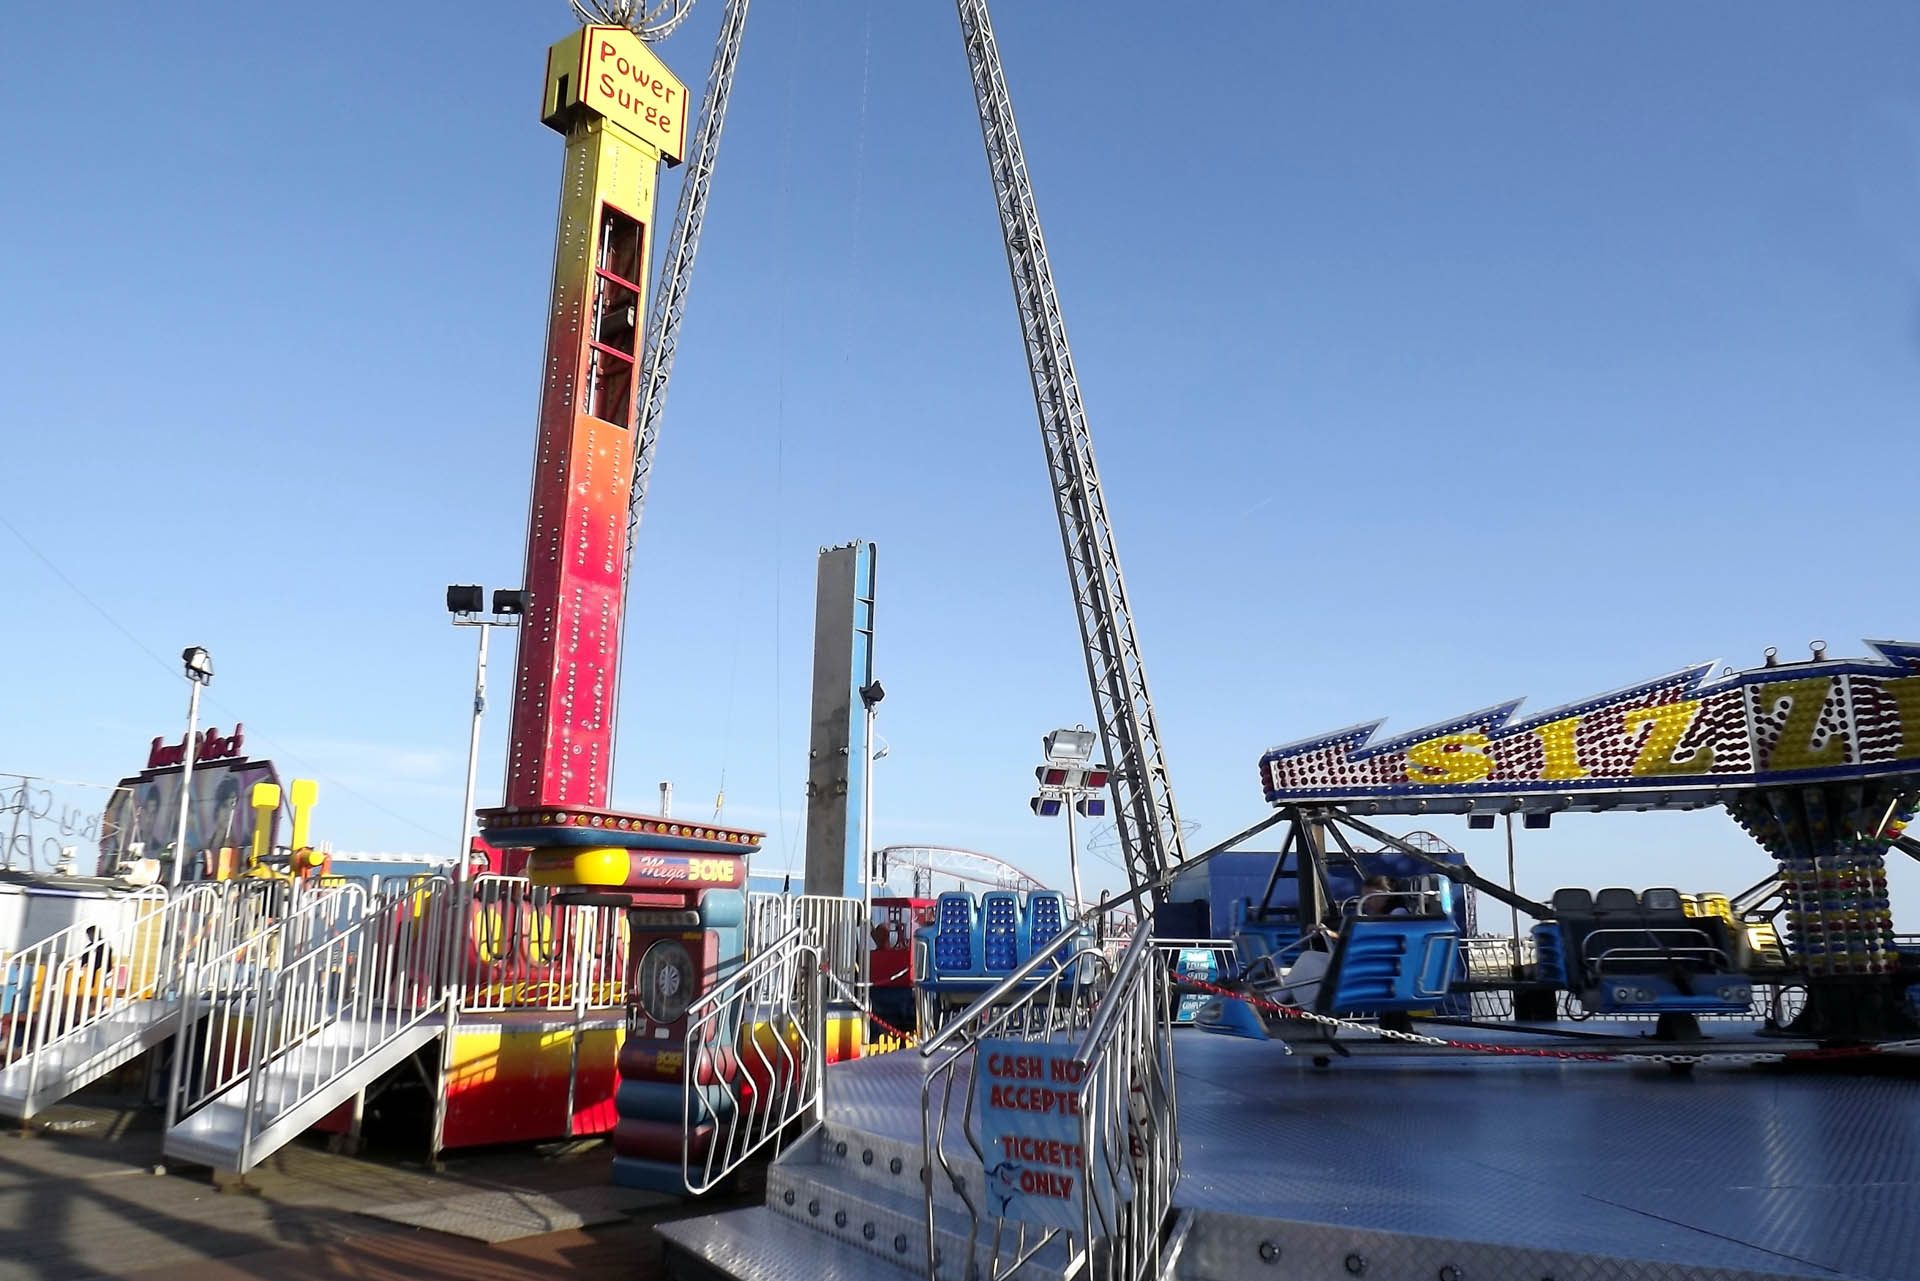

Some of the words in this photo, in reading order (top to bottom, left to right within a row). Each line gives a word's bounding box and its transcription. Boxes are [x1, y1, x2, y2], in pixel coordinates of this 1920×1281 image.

[600, 40, 676, 104] Power
[599, 73, 671, 133] Surge
[641, 856, 687, 884] Mega
[988, 1052, 1044, 1081] CASH
[990, 1084, 1082, 1118] ACCEPTE
[1020, 1170, 1074, 1201] ONLY
